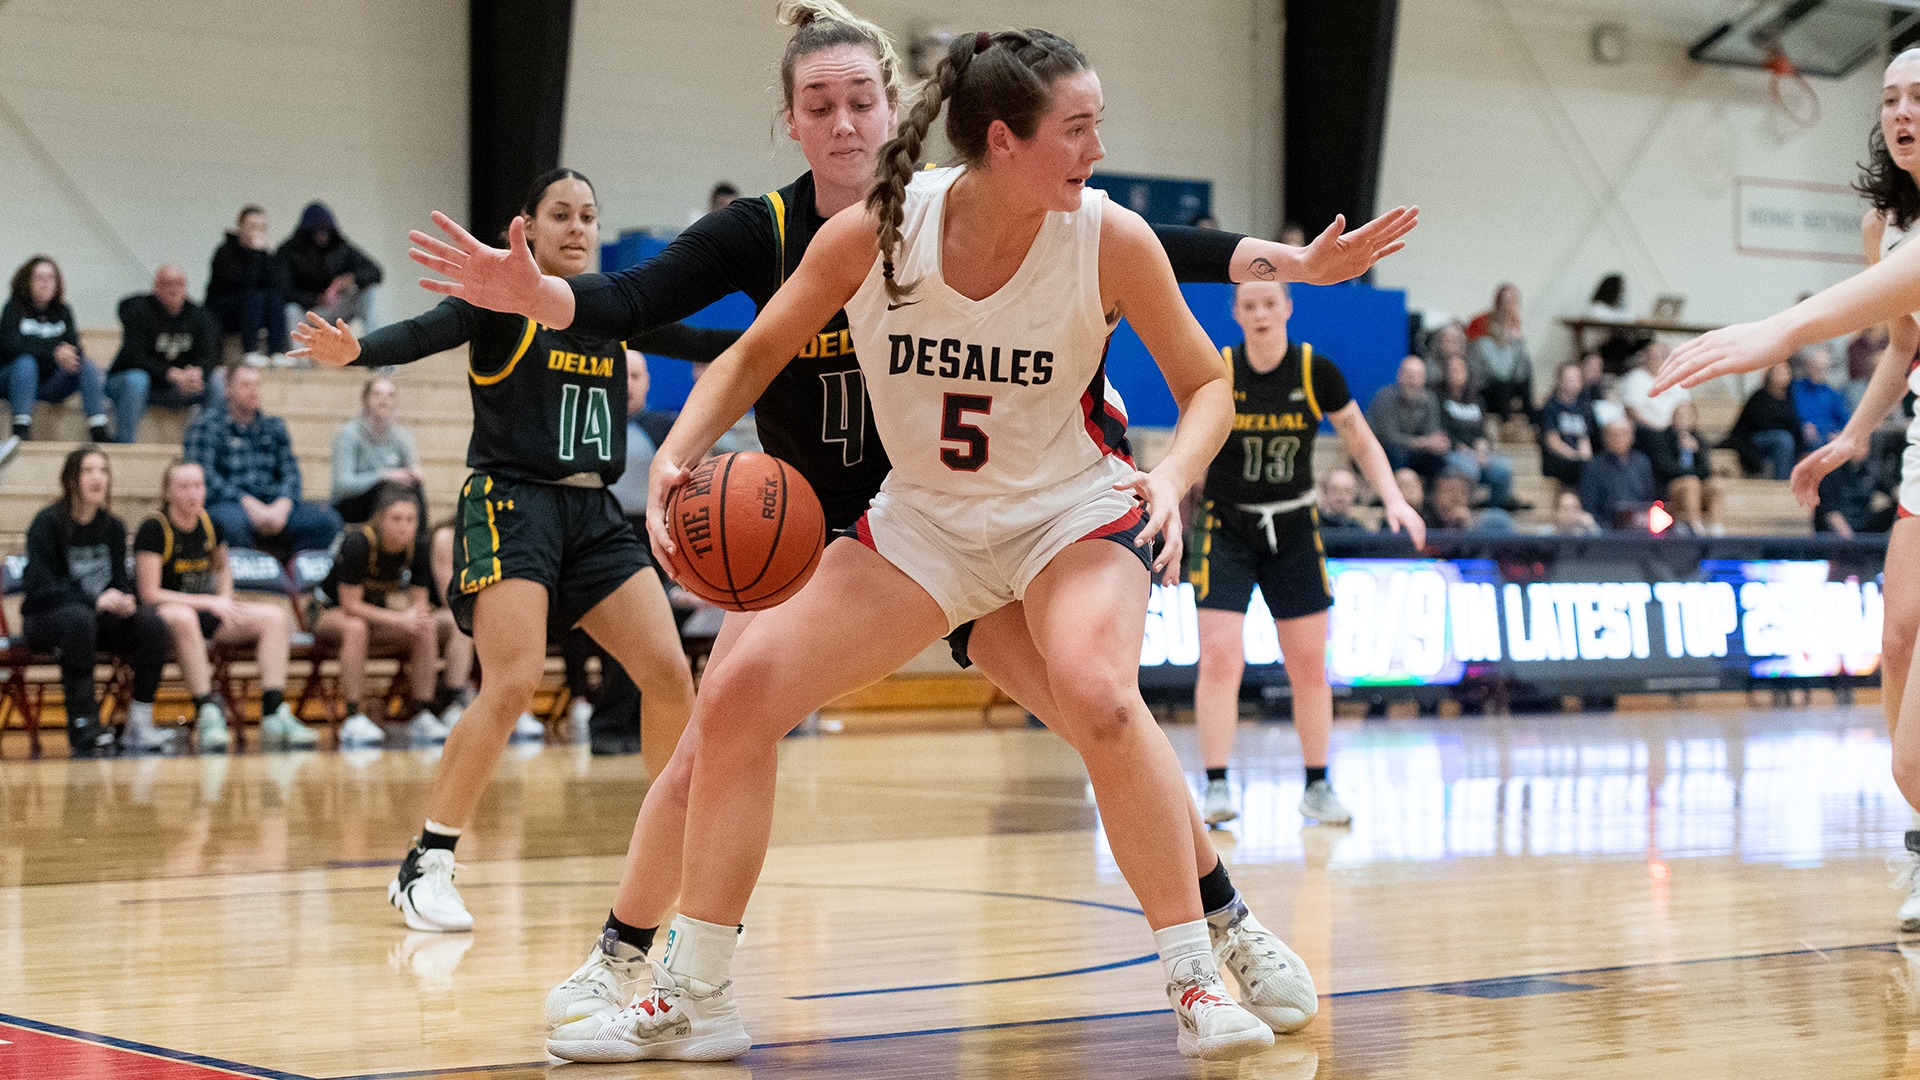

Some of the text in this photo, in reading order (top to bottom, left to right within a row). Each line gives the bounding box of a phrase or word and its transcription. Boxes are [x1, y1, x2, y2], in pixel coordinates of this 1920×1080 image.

[798, 328, 856, 358] DEL
[888, 334, 1054, 387] DESALES
[559, 383, 611, 460] 14
[818, 368, 866, 467] 4
[940, 392, 993, 472] 5
[1241, 436, 1301, 484] 13
[762, 476, 778, 520] ROCK
[682, 506, 713, 559] THE
[1502, 582, 1652, 662] LATEST
[1653, 582, 1738, 658] TOP
